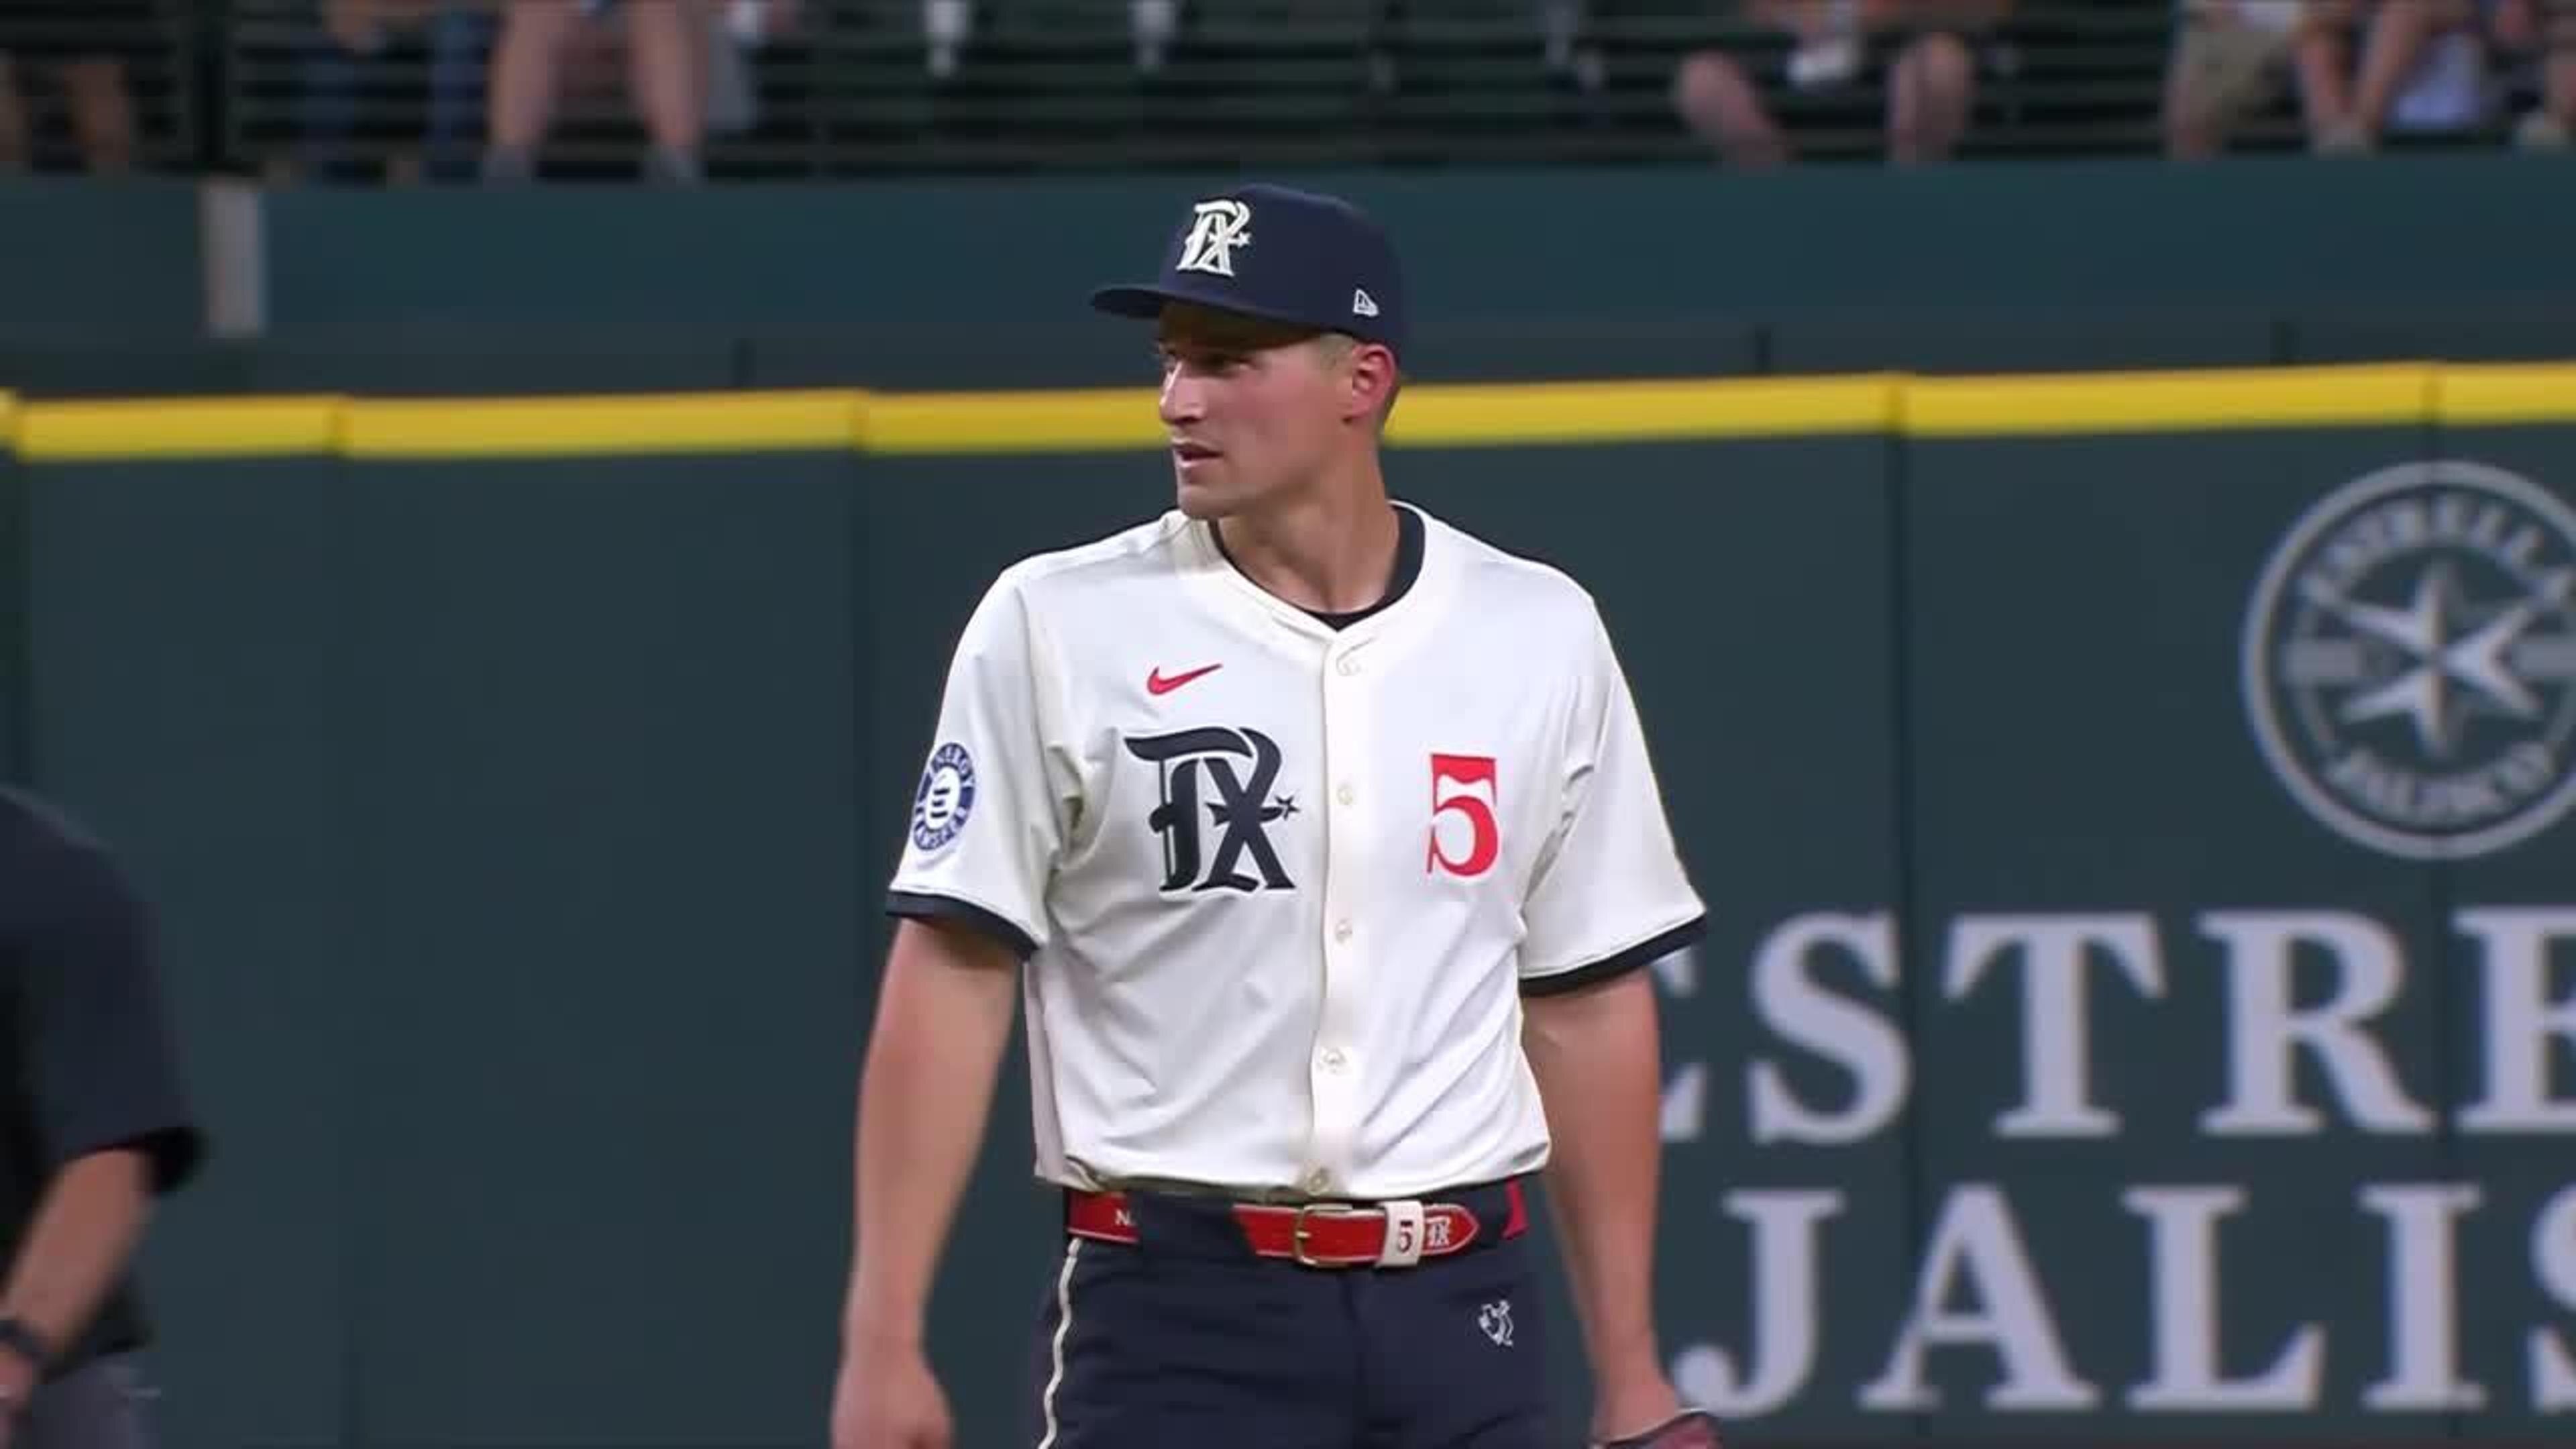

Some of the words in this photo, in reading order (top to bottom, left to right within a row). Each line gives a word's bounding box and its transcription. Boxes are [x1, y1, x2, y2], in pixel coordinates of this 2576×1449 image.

[1426, 752, 1499, 878] 5
[1660, 906, 2576, 1144] STRE
[1399, 1220, 1413, 1253] 5
[1676, 1183, 2576, 1419] JALI
